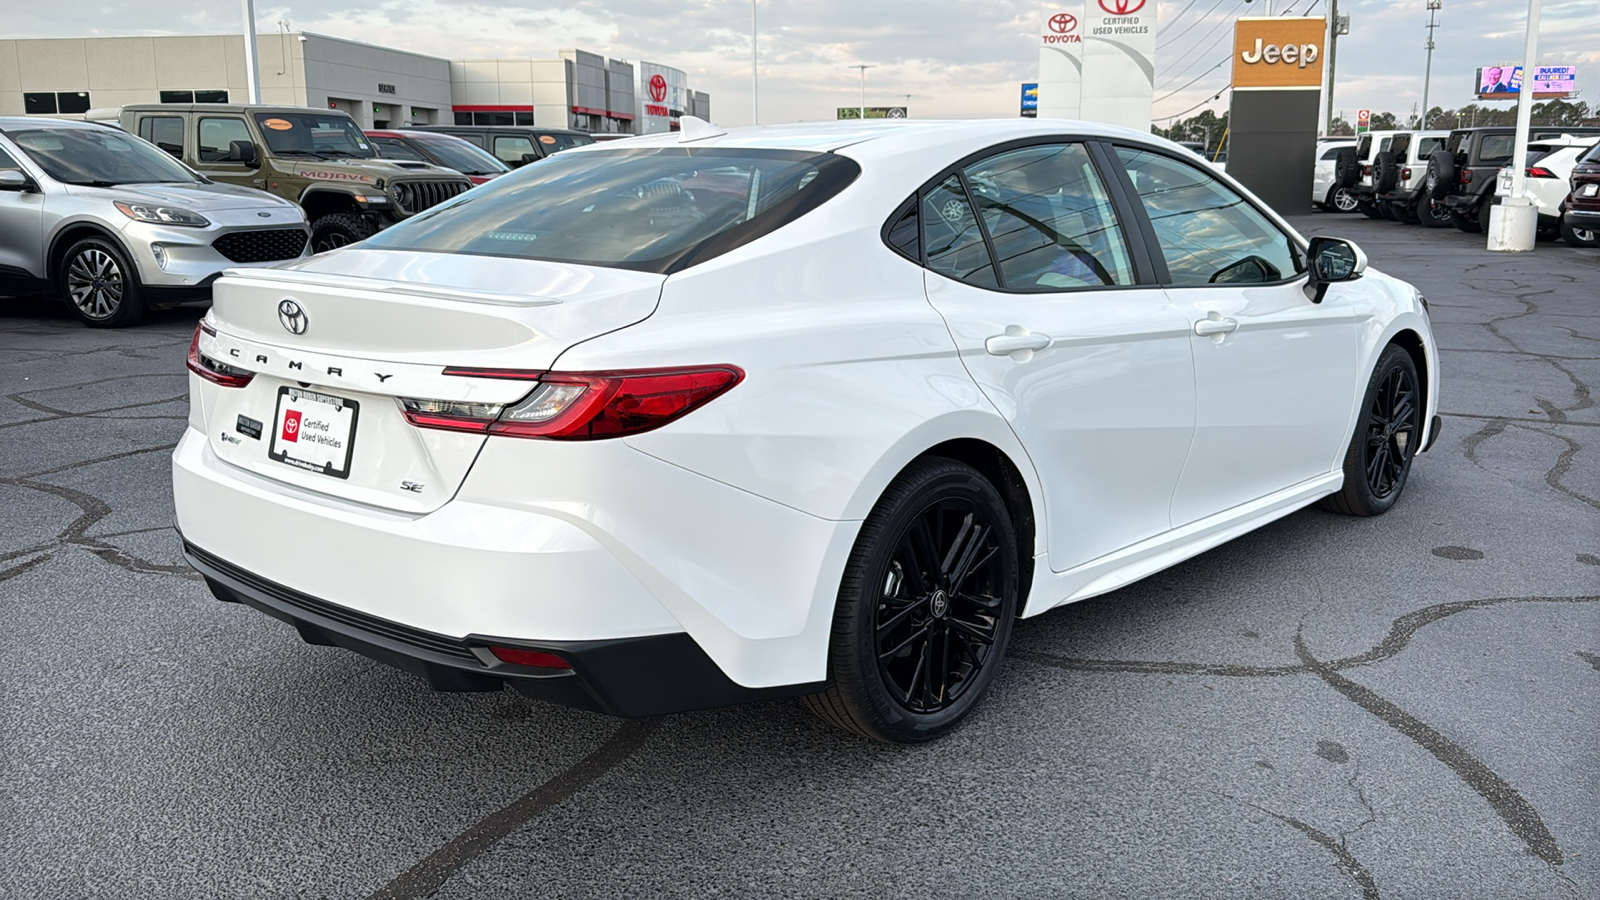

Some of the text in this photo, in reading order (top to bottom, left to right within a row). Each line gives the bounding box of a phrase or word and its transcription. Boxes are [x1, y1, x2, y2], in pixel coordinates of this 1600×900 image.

[1102, 17, 1140, 25] CERTIFIED
[1093, 26, 1149, 35] USED VEHICLES
[1042, 35, 1082, 44] TOYOTA
[1241, 38, 1319, 69] Jeep
[645, 104, 669, 117] TOYOTA
[299, 170, 371, 182] MOJAVE
[230, 348, 393, 383] CAMRY
[303, 417, 330, 432] Certified
[301, 430, 342, 449] Used Vehicles
[400, 480, 425, 494] SE
